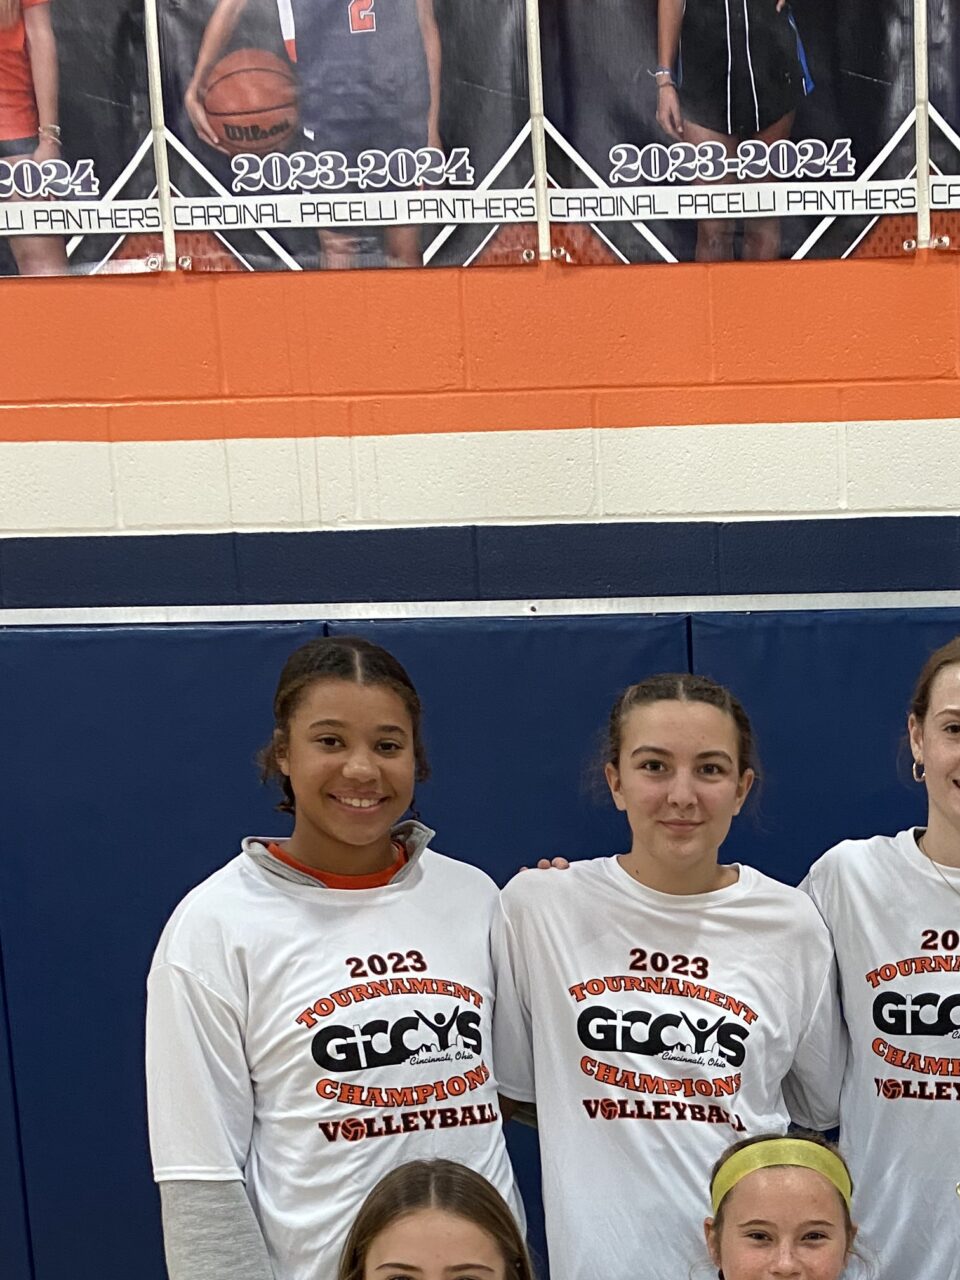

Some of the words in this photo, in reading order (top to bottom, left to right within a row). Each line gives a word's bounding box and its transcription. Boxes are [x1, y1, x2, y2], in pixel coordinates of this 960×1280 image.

[231, 147, 475, 192] 2023-2024
[609, 139, 856, 183] 2023-2024
[173, 203, 291, 226] CARDINAL
[300, 200, 397, 223] PACELLI
[407, 197, 535, 219] PANTHERS
[550, 194, 668, 218] CARDINAL
[678, 190, 776, 215] PACELLI
[787, 187, 916, 212] PANTHERS
[34, 207, 161, 230] PANTHERS
[345, 950, 427, 979] 2023
[629, 948, 709, 979] 2023
[295, 978, 484, 1029] TOURNAMENT
[569, 976, 758, 1025] TOURNAMENT
[311, 1005, 482, 1072] GCCYS
[577, 1005, 749, 1067] GCCYS
[455, 1051, 474, 1061] Ohio
[708, 1057, 726, 1068] Ohio
